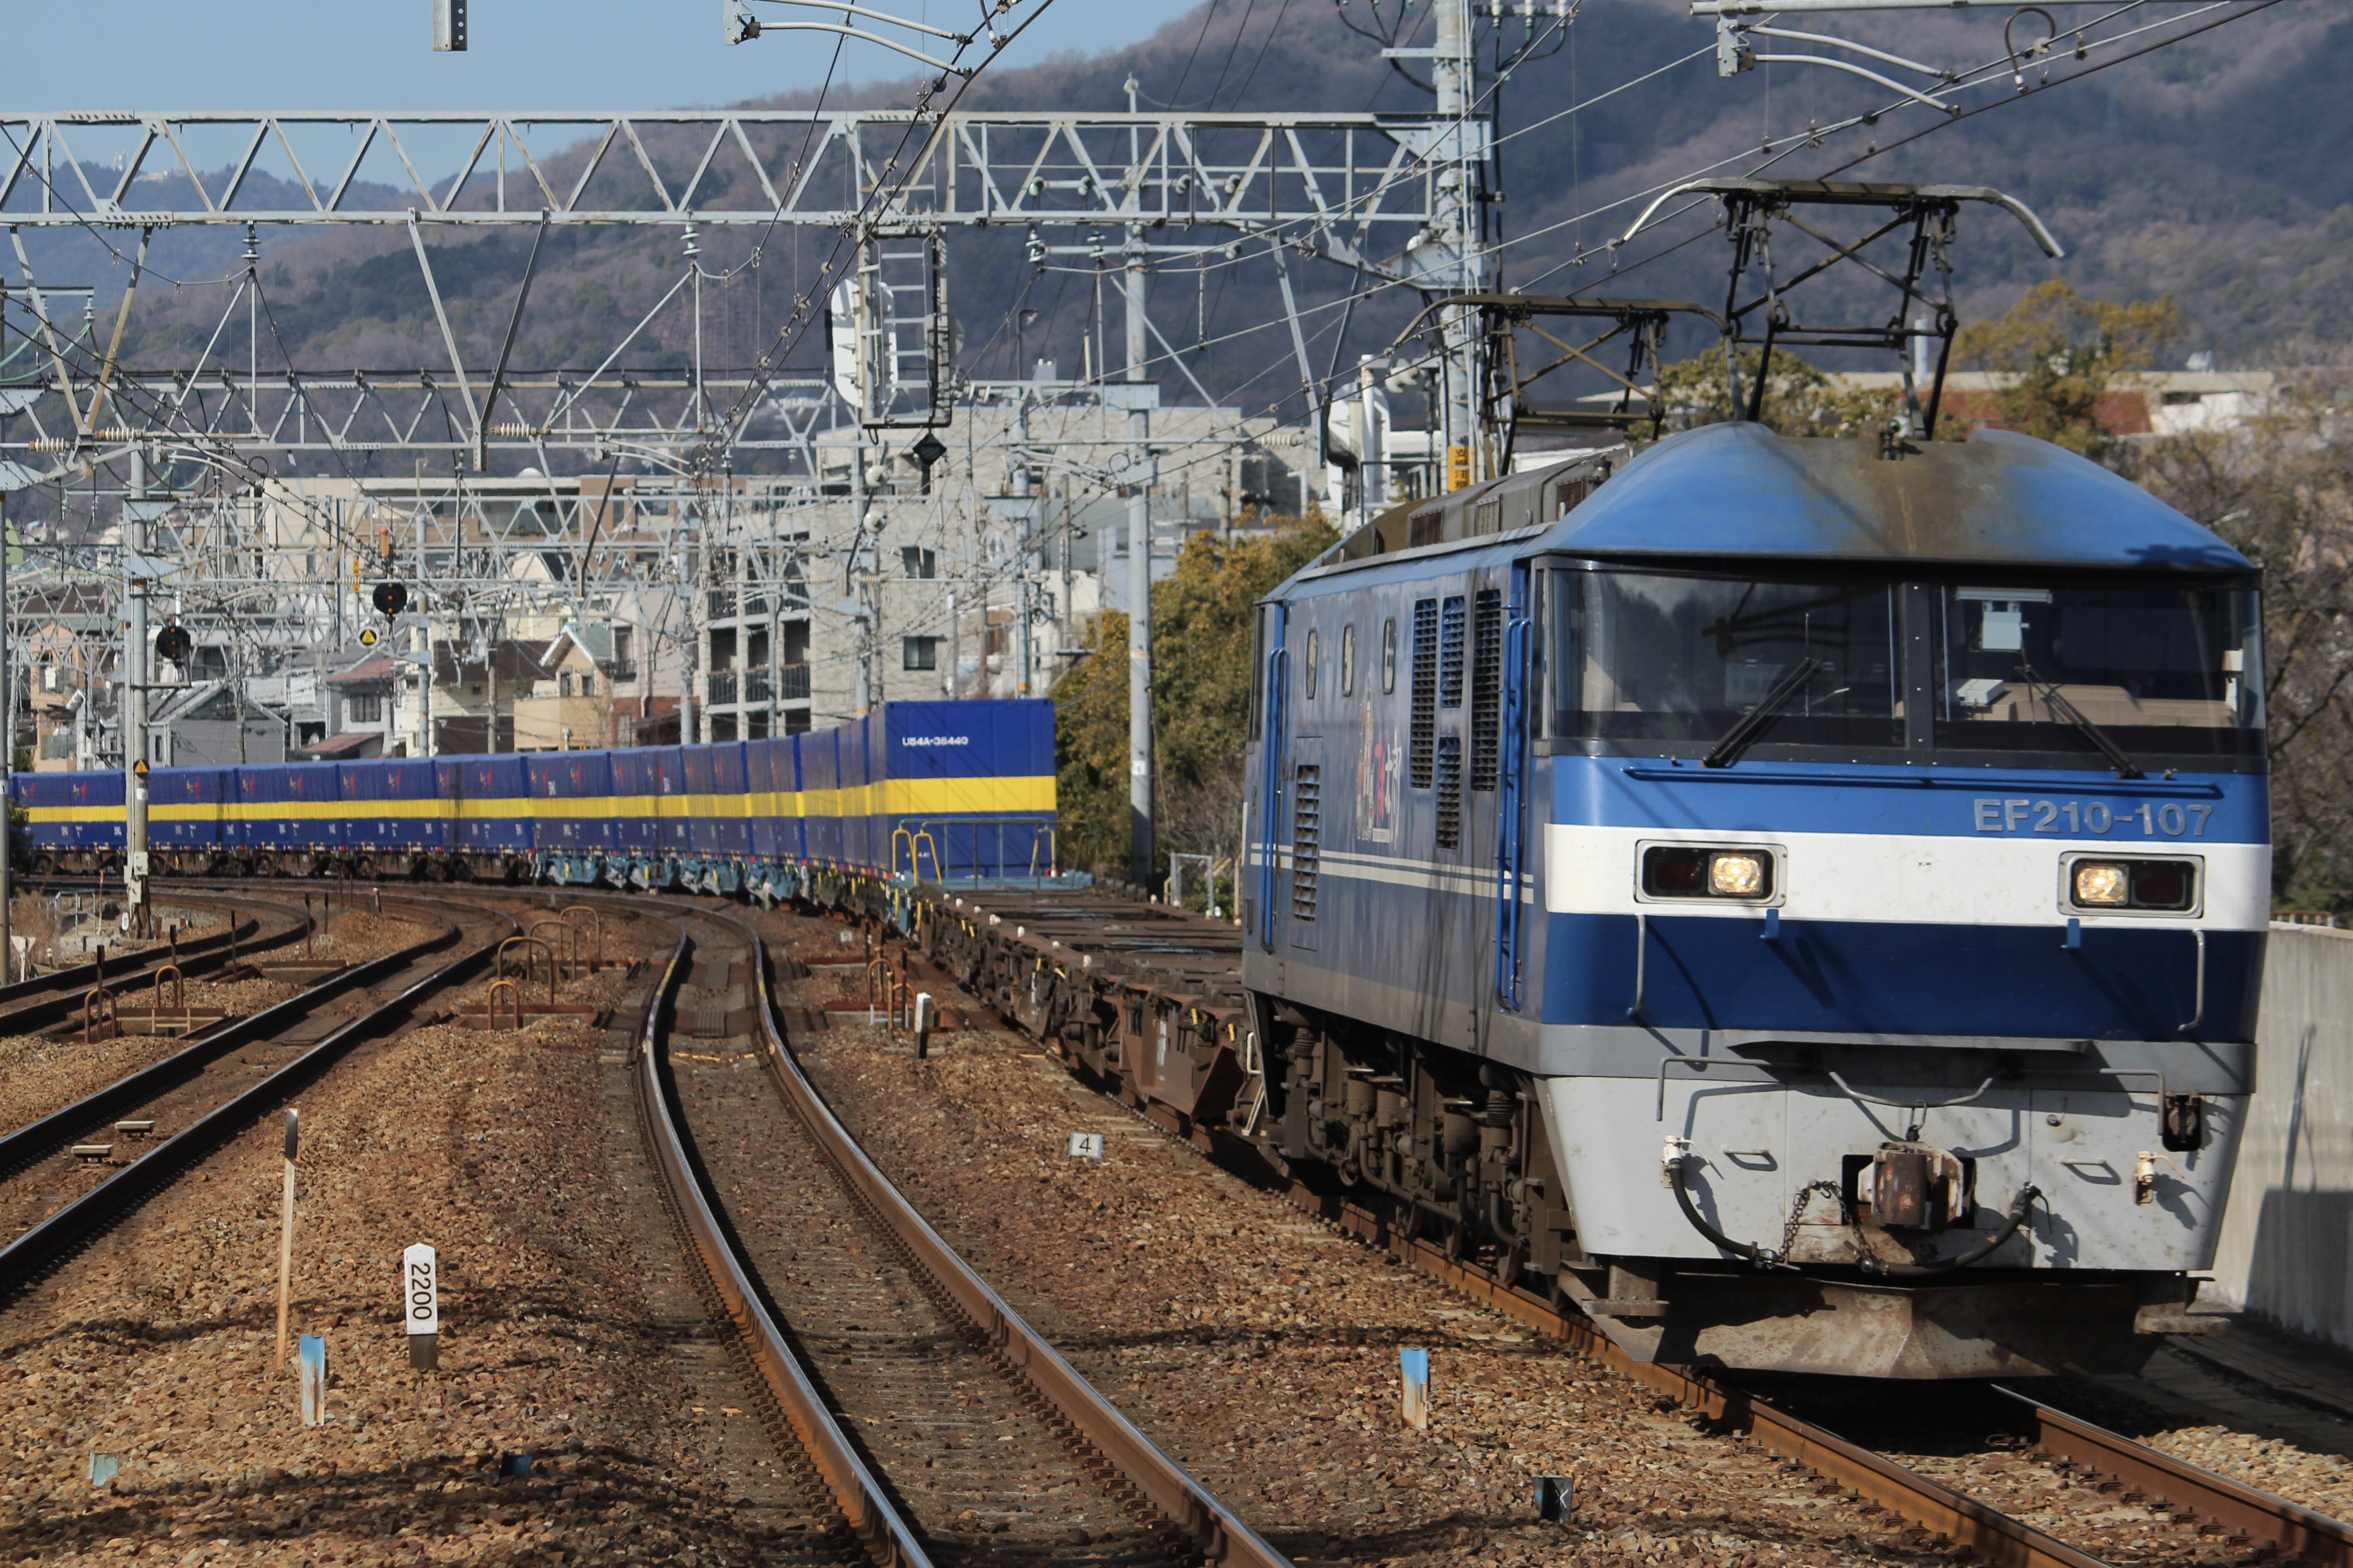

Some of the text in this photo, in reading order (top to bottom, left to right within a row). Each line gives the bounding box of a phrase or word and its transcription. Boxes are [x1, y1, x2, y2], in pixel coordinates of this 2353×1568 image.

[1974, 799, 2212, 836] EF210-107
[1079, 1134, 1091, 1152] 4
[411, 1262, 433, 1320] 2200
